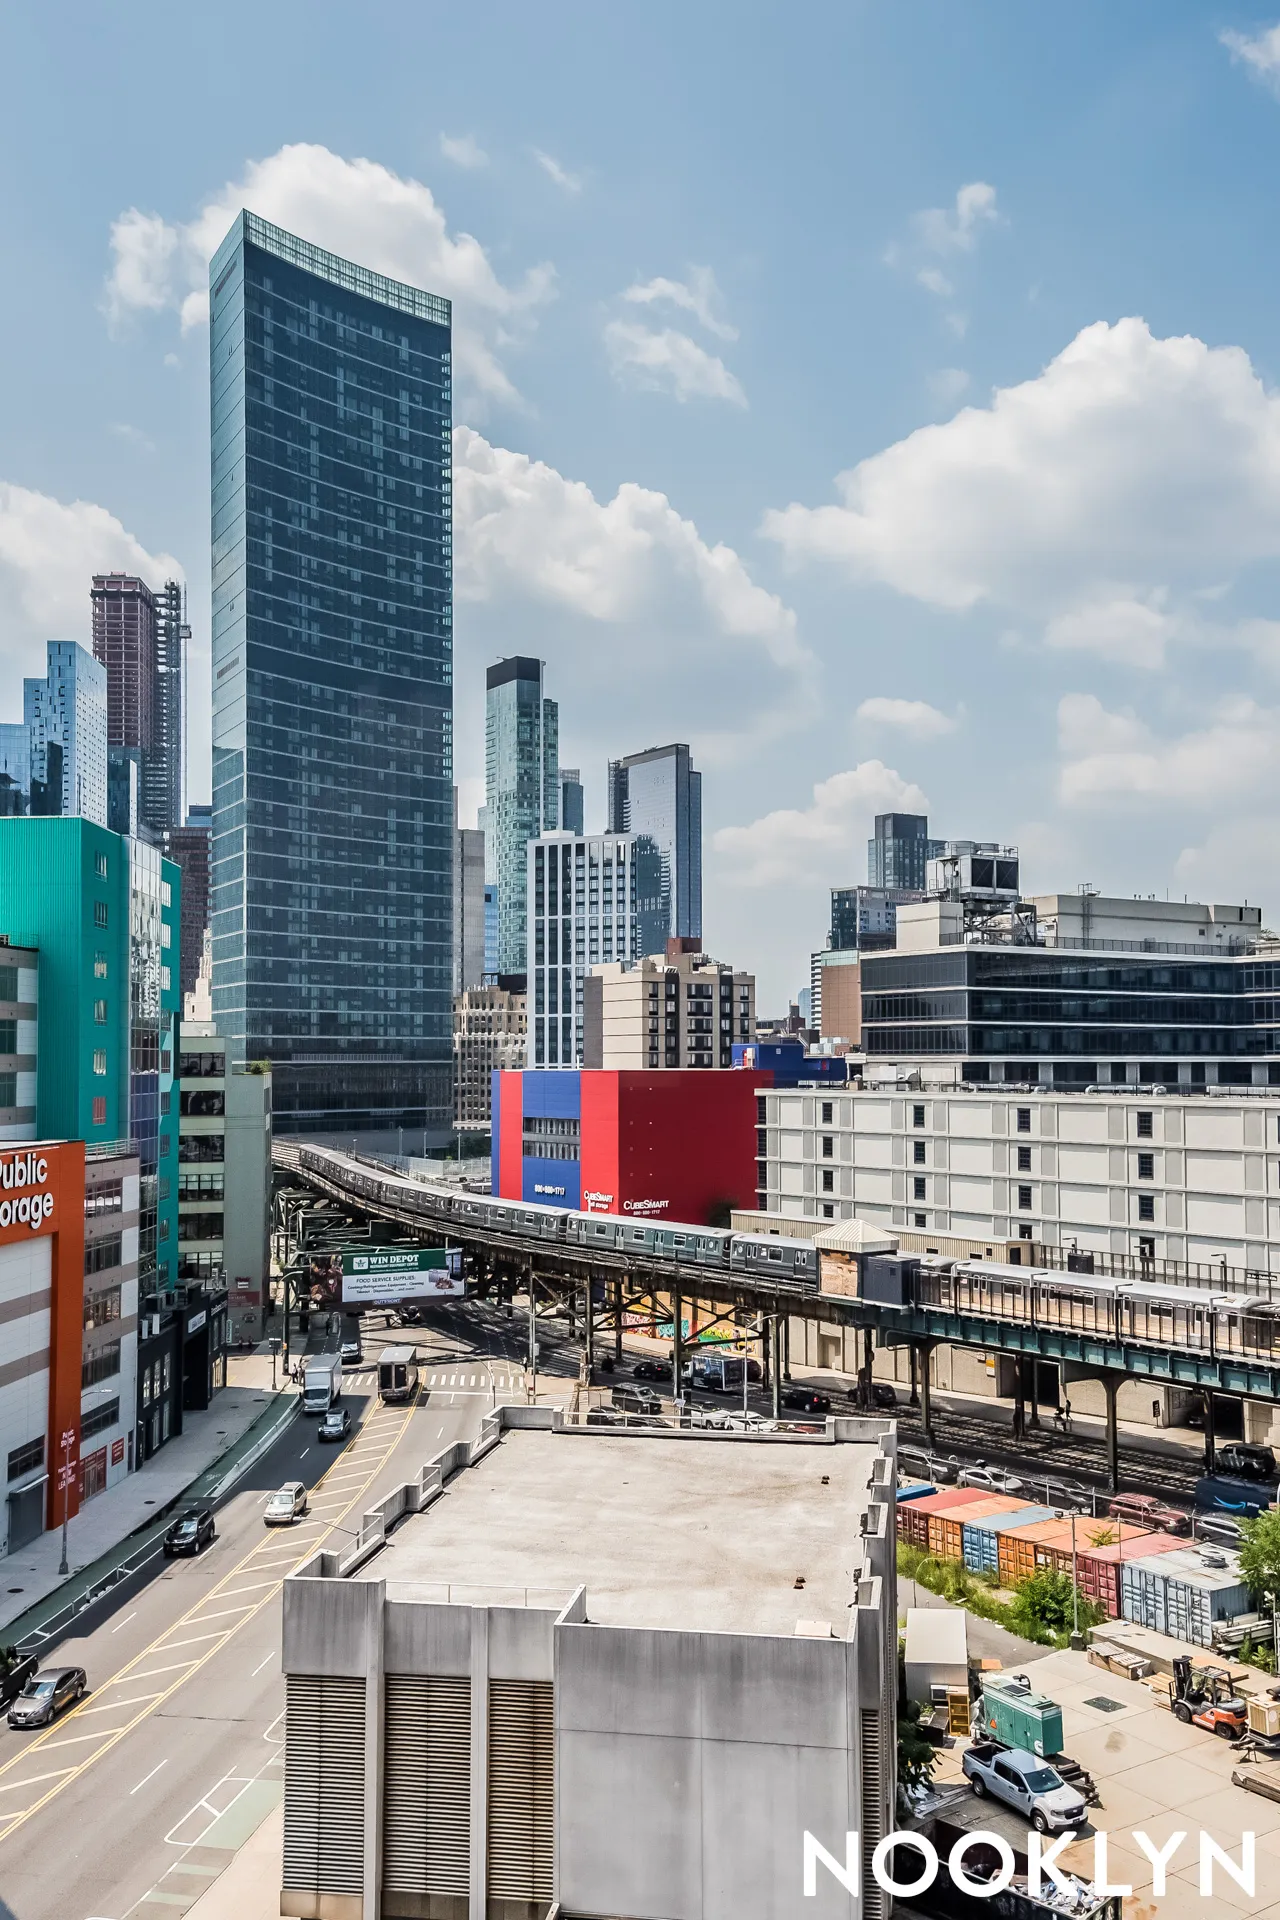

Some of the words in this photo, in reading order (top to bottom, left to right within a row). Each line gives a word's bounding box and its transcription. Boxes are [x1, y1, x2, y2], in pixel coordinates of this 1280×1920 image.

[0, 1153, 48, 1189] ublic
[0, 1192, 54, 1230] orage
[370, 1256, 389, 1264] WIN
[390, 1254, 419, 1263] DEPOT
[1246, 1501, 1260, 1509] prime
